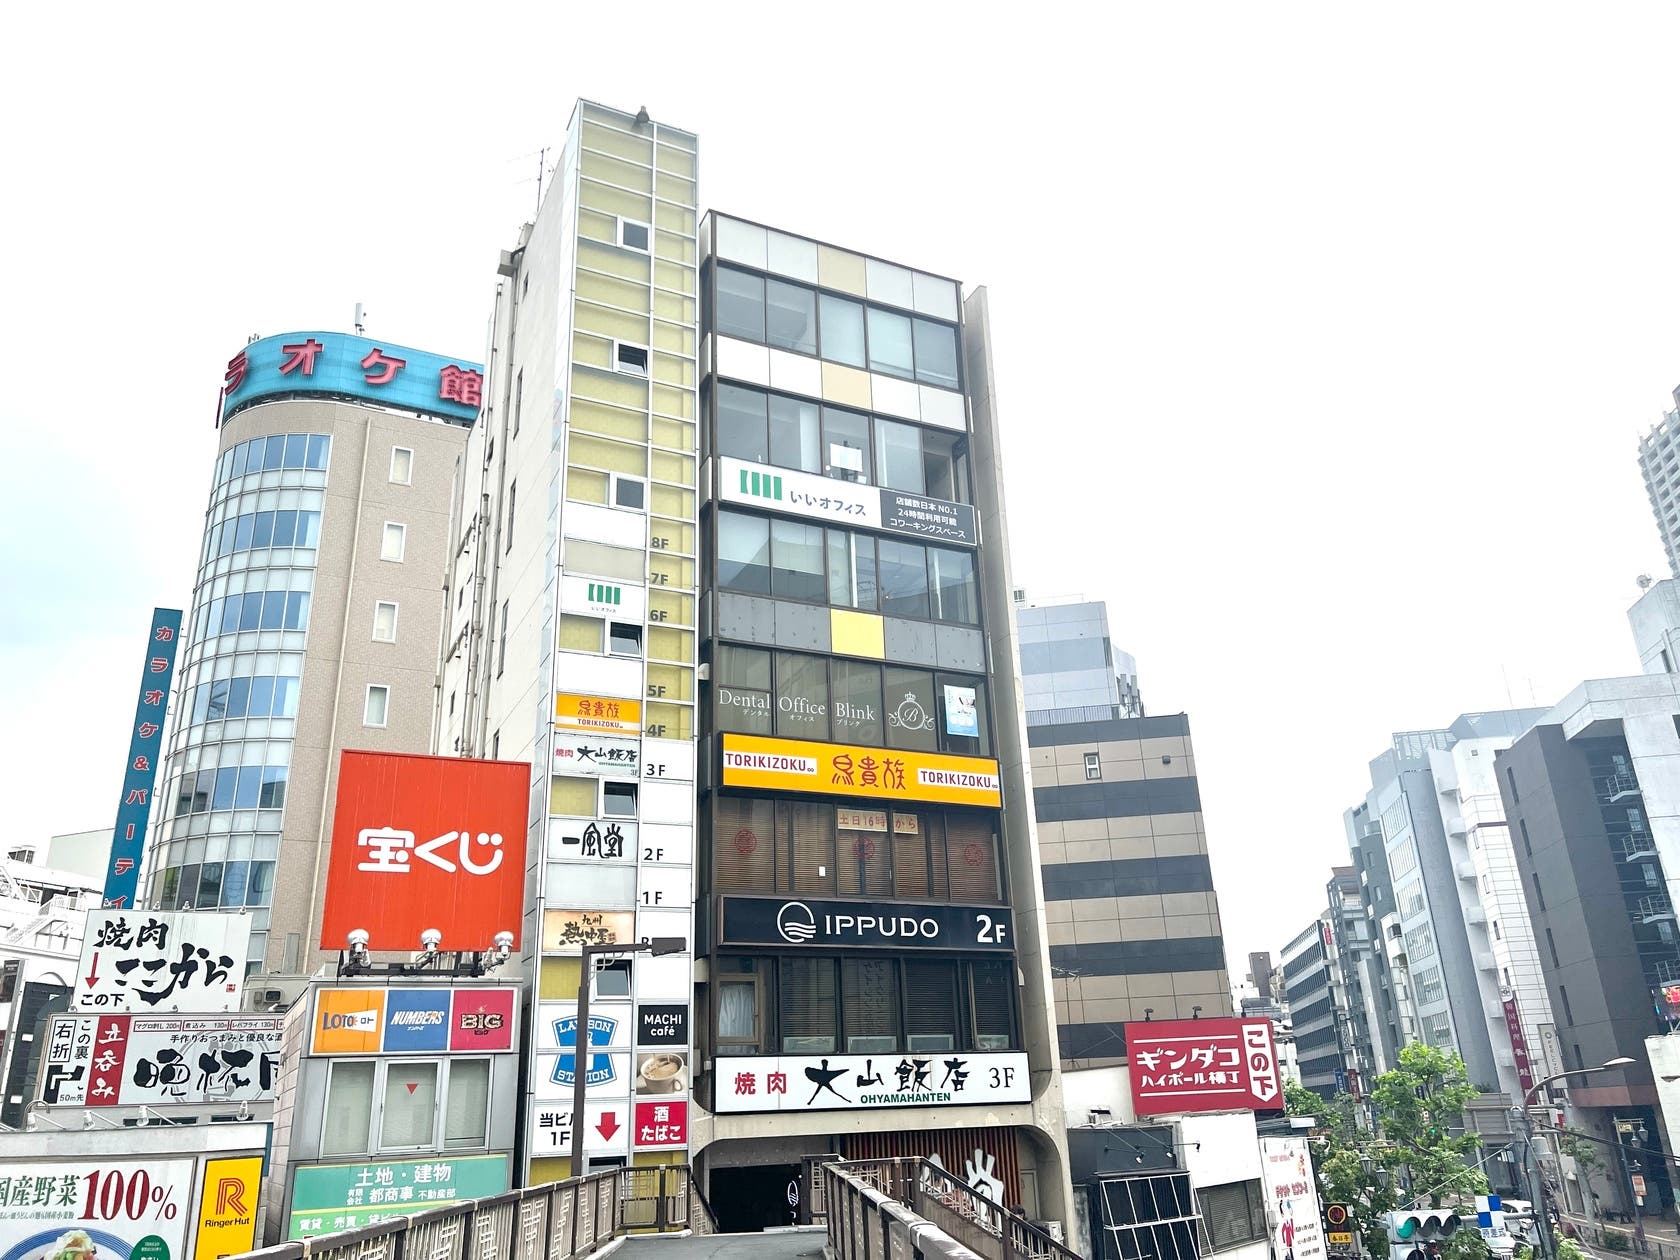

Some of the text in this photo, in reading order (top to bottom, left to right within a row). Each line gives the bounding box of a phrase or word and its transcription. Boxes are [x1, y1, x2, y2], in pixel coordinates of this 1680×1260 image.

[791, 491, 867, 516] いいオフィス
[938, 504, 958, 515] NO.1
[898, 508, 958, 527] 24時間利用可能
[890, 518, 966, 539] コワーキングスペース
[651, 537, 669, 549] 8F
[651, 573, 669, 585] 7F
[650, 610, 667, 622] 6F
[648, 685, 666, 698] 5F
[578, 700, 620, 719] 鳥貴族
[719, 690, 875, 721] Dental Office Blink
[578, 718, 620, 728] TORIKIZOKU
[647, 725, 666, 737] 4F
[555, 746, 638, 763] 焼肉 大山飯店
[725, 753, 806, 772] TORIKIZOKU
[646, 763, 666, 776] 3F
[832, 754, 906, 790] 鳥貴族
[920, 770, 991, 789] TORIKIZOKU
[839, 812, 916, 830] 土日16時 から
[562, 822, 624, 859] 一風堂
[357, 827, 504, 875] 宝くじ
[643, 848, 664, 861] 2F
[642, 891, 663, 905] 1F
[582, 914, 603, 925] 九州
[93, 916, 169, 951] 焼肉
[825, 914, 1006, 943] IPPUDO 2F
[115, 943, 235, 1006] ここから
[81, 993, 125, 1007] この下
[323, 1012, 354, 1030] LOTO
[391, 1010, 445, 1025] NUMBERS
[460, 1013, 504, 1030] BIG
[559, 1019, 612, 1033] LASON
[644, 1014, 682, 1025] MACHI
[650, 1025, 675, 1036] café
[51, 1023, 74, 1060] 右折
[74, 1020, 91, 1060] この裏
[91, 1023, 126, 1100] 立呑み
[1136, 1043, 1241, 1071] ギンダコ
[1247, 1030, 1274, 1096] この下
[734, 1057, 1015, 1105] 焼肉 大山飯店 3F
[1141, 1070, 1240, 1088] ハイボール横丁
[59, 1094, 84, 1102] 50m先
[860, 1092, 951, 1104] OHYAMAHANTEN
[654, 1106, 670, 1123] 酒
[550, 1131, 571, 1146] 1F
[641, 1125, 681, 1142] たばこ
[355, 1163, 452, 1188] 土地・建物
[77, 1169, 177, 1221] 100%
[369, 1186, 414, 1204] 都商事
[417, 1188, 457, 1200] 不動産部
[205, 1216, 250, 1228] Ringer Hut
